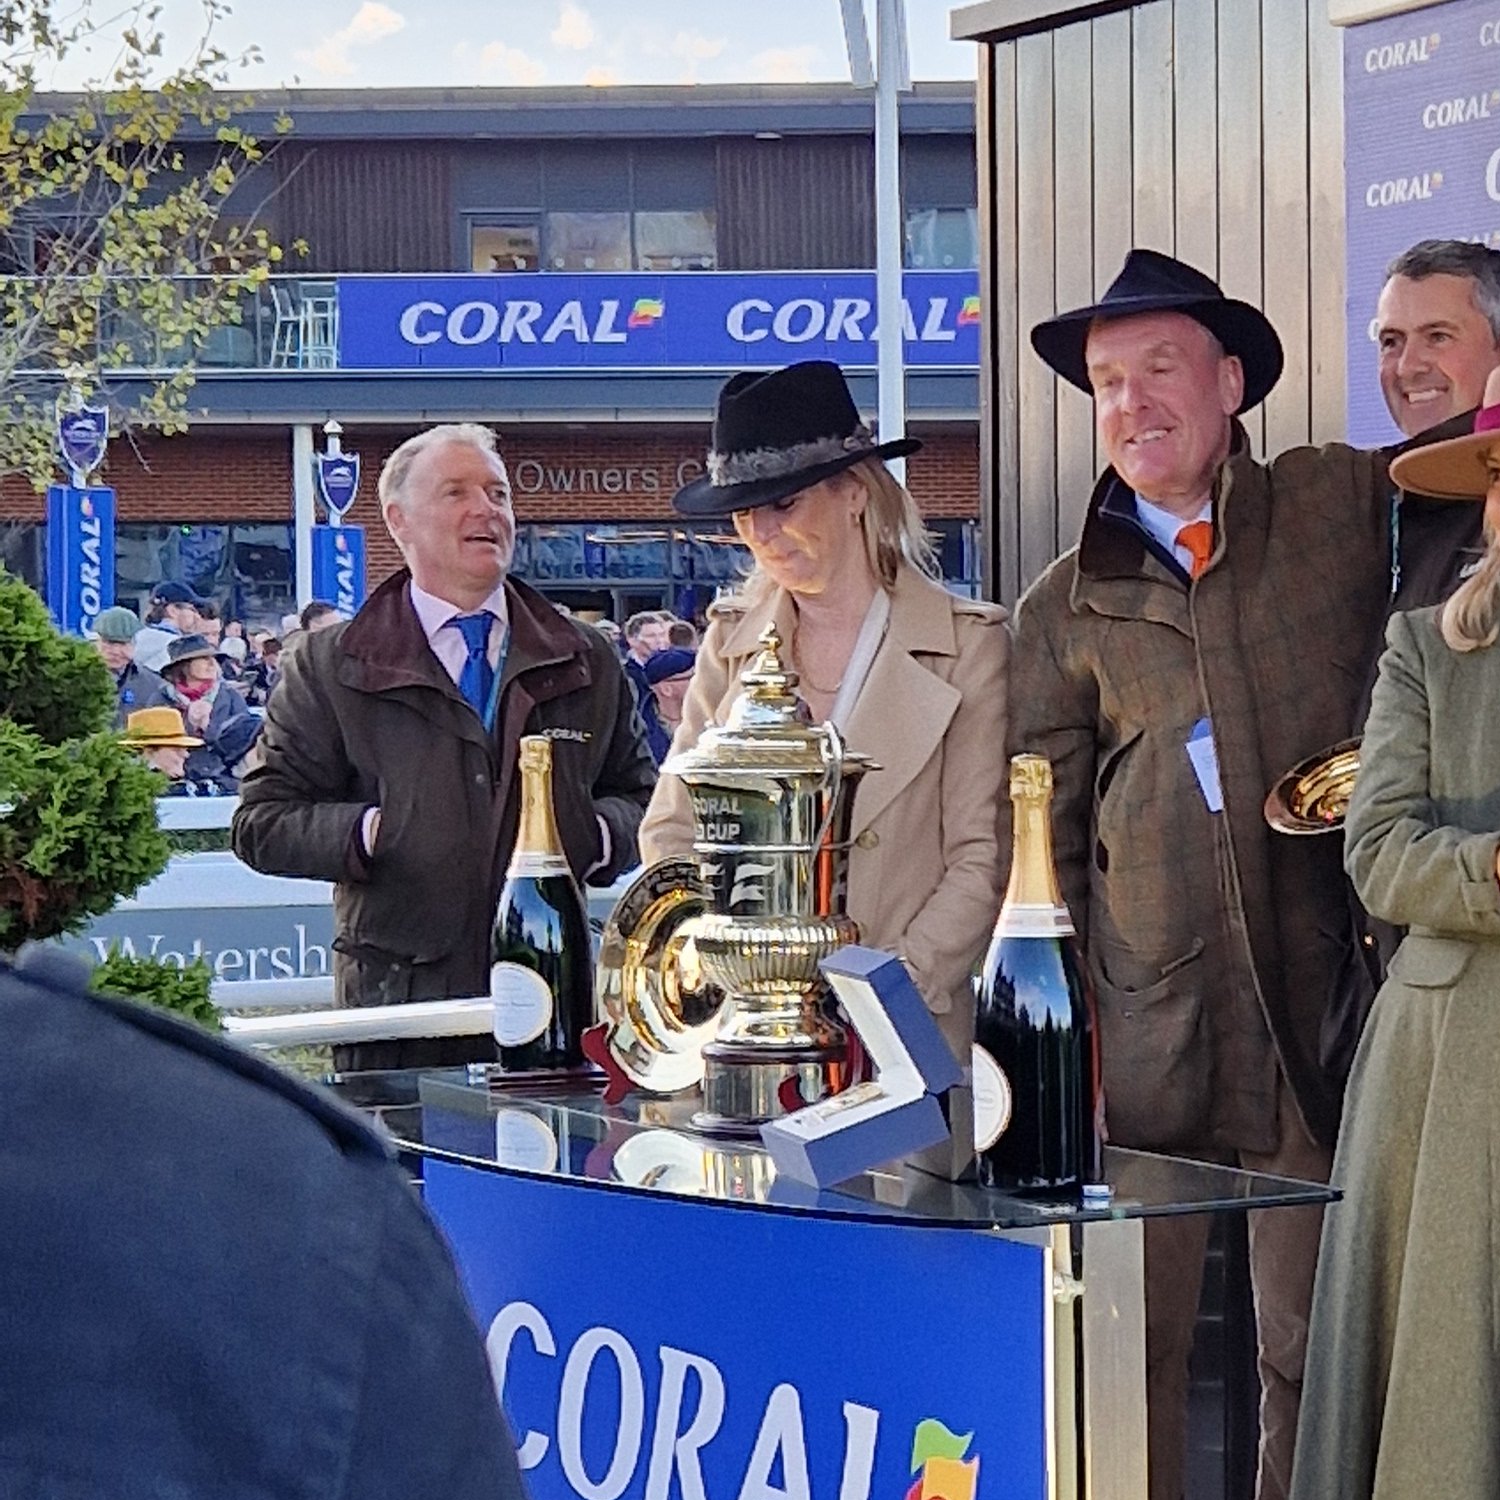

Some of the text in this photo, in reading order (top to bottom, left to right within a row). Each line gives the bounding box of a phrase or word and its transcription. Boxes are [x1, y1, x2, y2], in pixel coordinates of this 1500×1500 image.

[1365, 39, 1430, 73] CORAL
[1423, 96, 1490, 129] CORAL
[1367, 177, 1433, 207] CORAL
[400, 299, 628, 346] CORAL
[516, 460, 658, 493] Owners
[80, 516, 101, 641] CORAL
[335, 552, 355, 619] RAL
[707, 822, 741, 841] CUP
